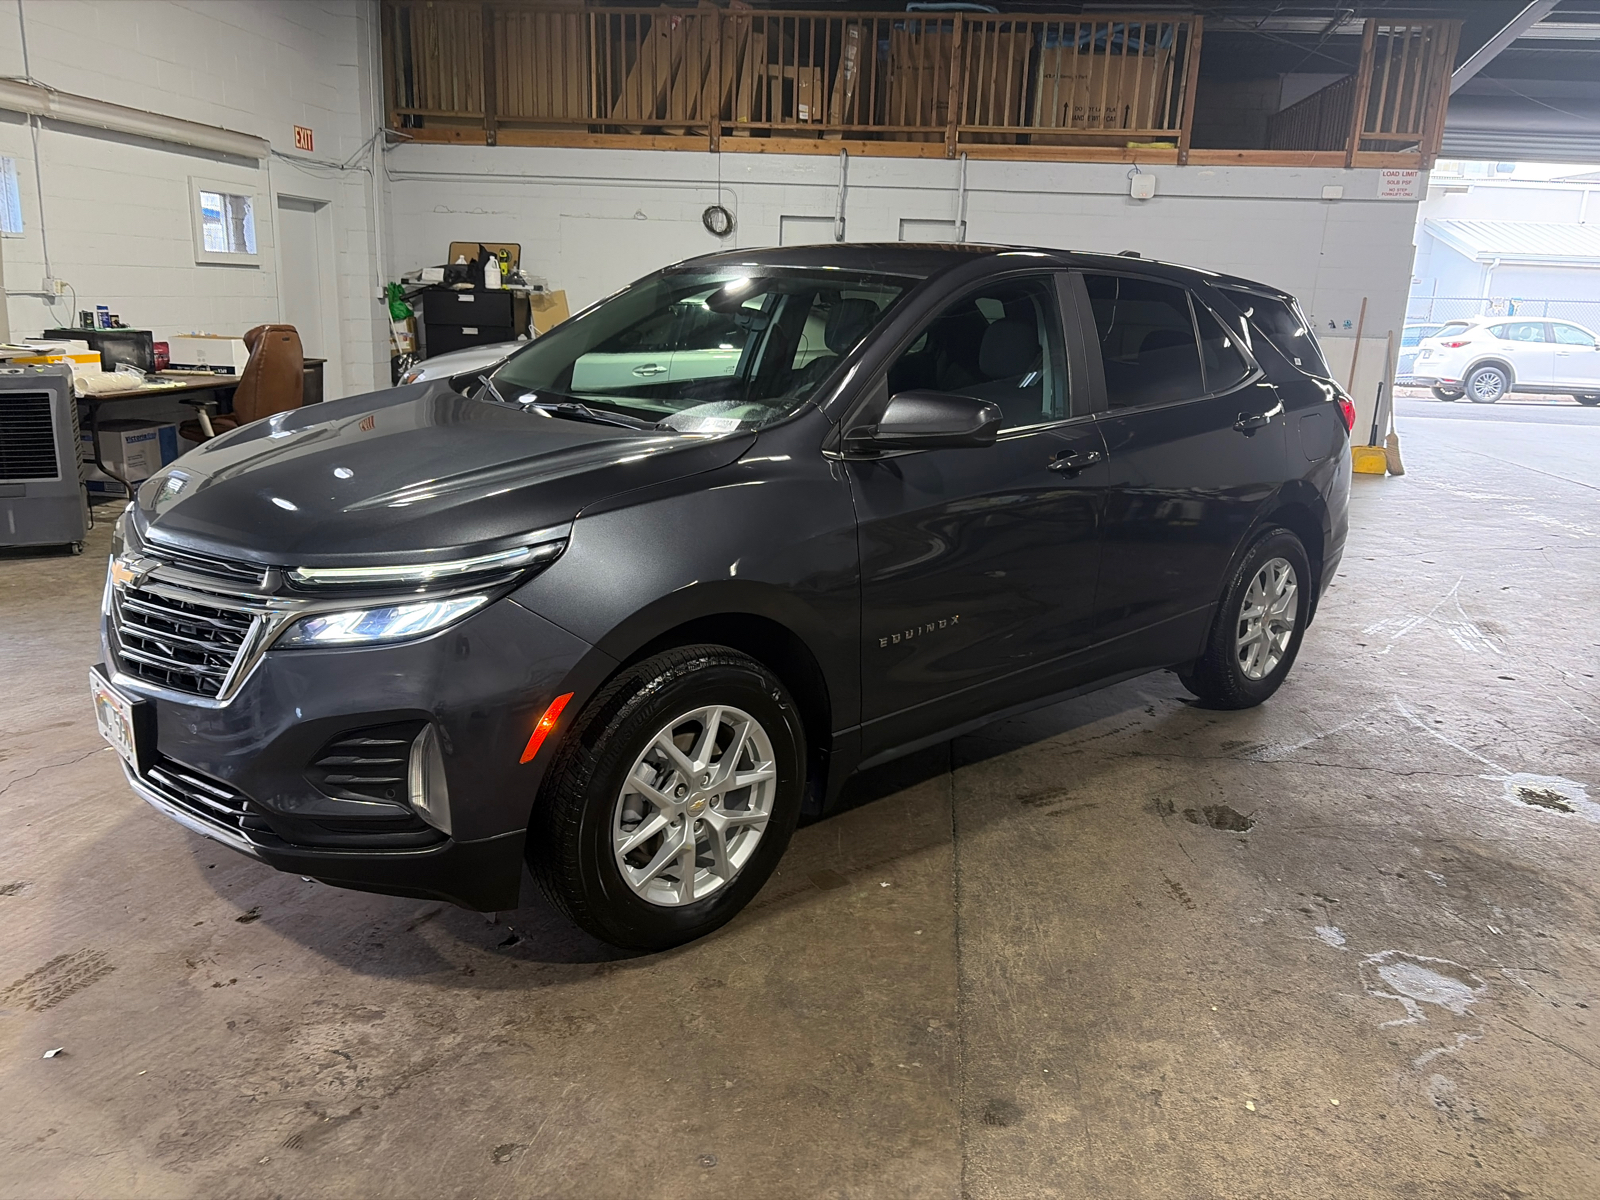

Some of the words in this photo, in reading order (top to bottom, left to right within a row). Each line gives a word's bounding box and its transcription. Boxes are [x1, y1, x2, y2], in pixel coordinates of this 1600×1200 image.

[1071, 114, 1090, 122] ANDE
[294, 126, 312, 151] EXIT
[1401, 170, 1418, 178] LIMIT
[878, 614, 960, 648] EQUINOX
